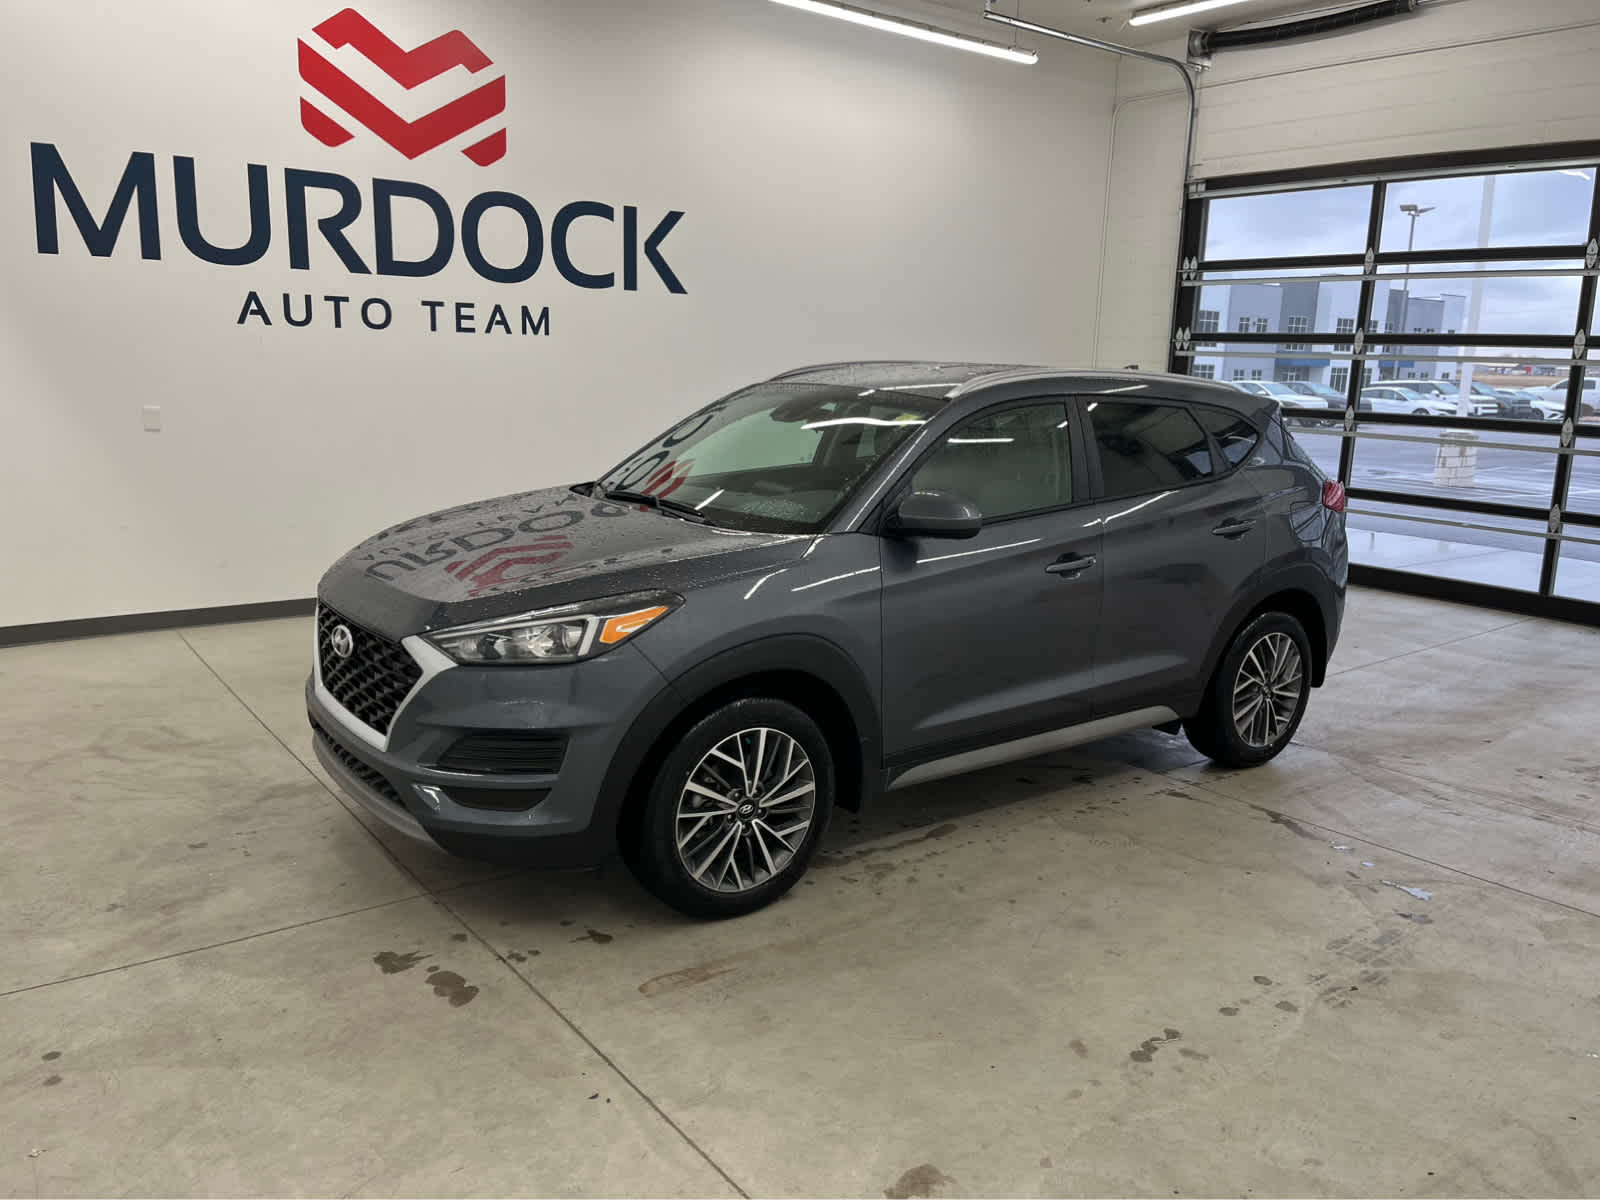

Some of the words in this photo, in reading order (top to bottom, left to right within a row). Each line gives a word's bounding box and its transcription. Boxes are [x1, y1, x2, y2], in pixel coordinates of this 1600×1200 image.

[30, 141, 688, 295] MURDOCK
[237, 291, 393, 330] AUTO
[421, 300, 550, 336] TEAM
